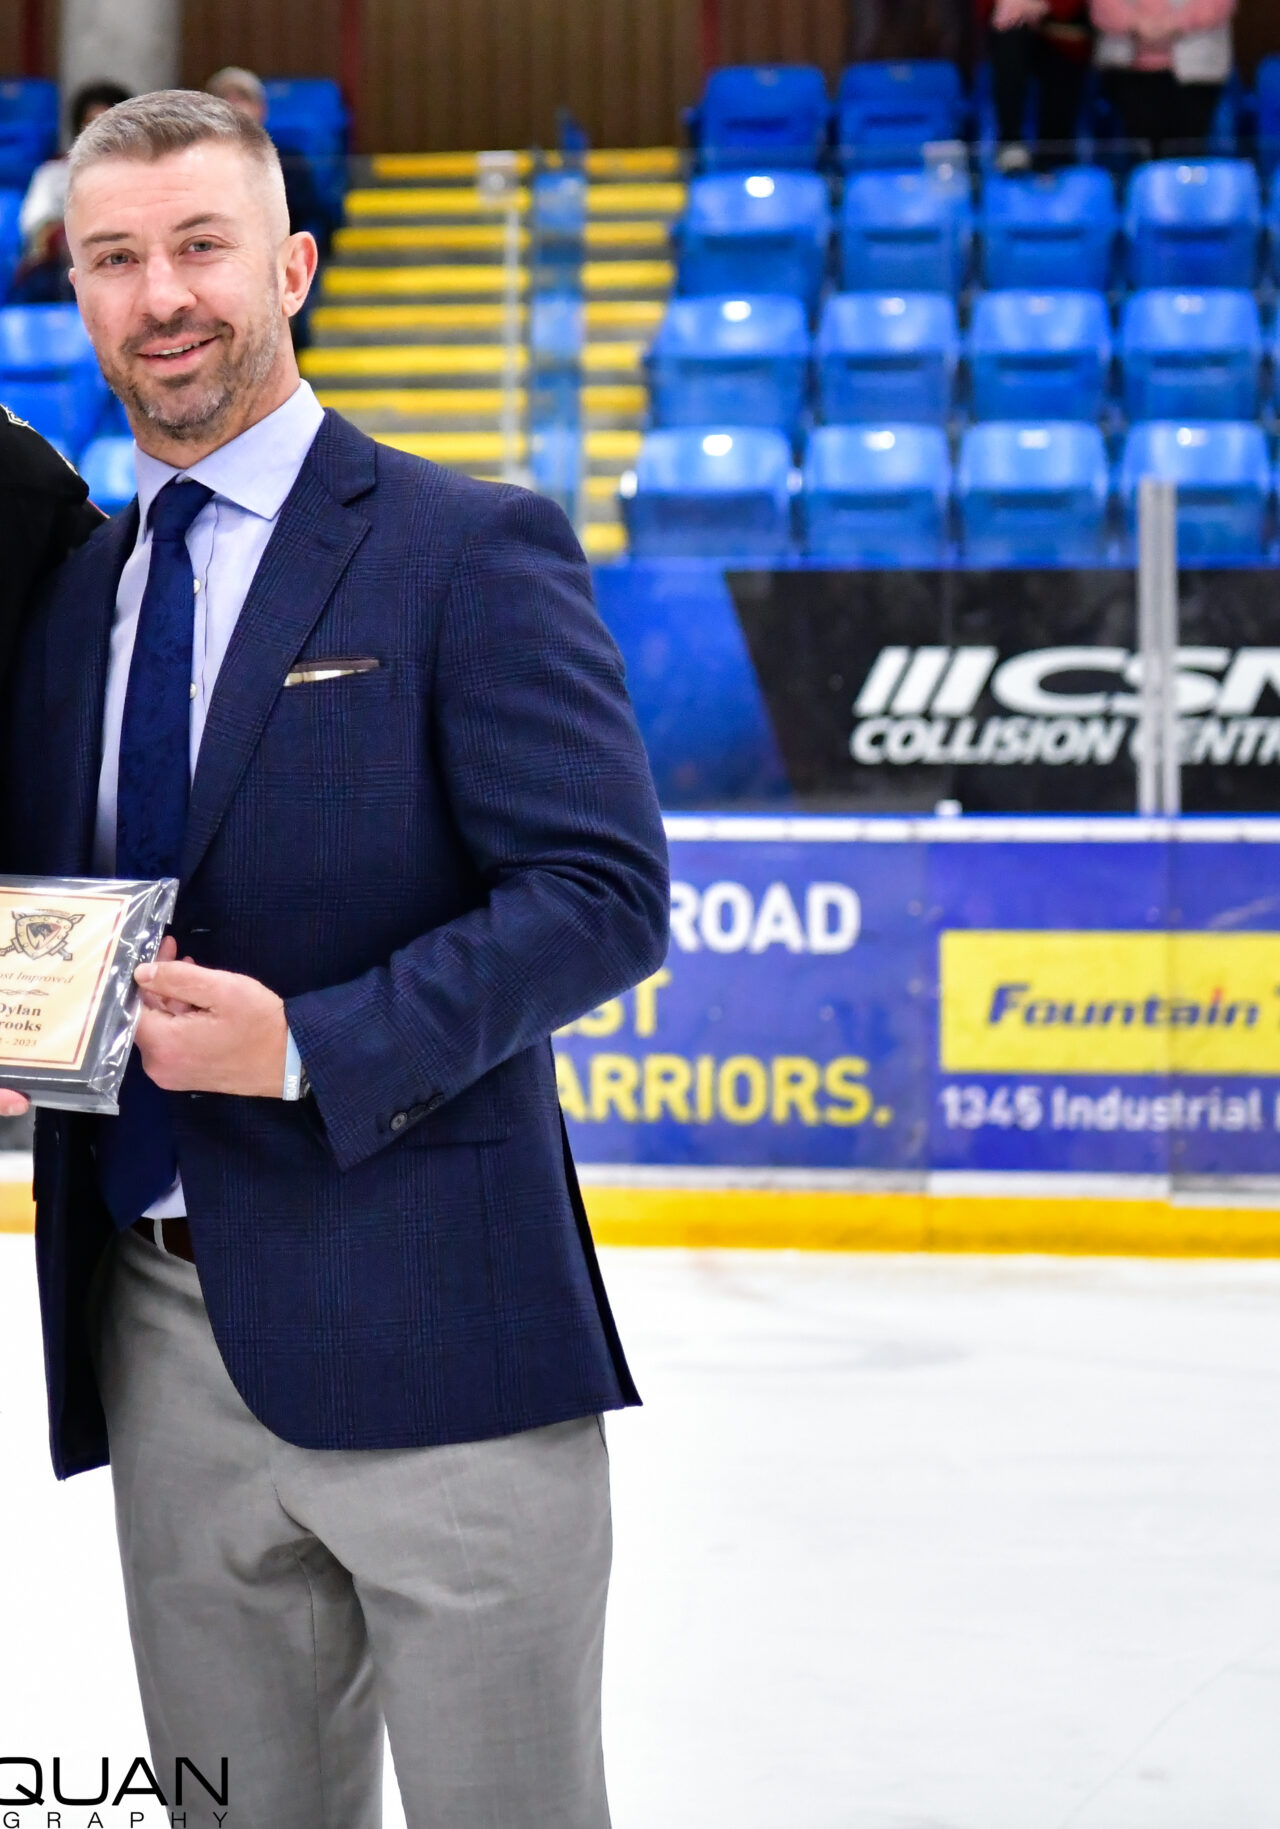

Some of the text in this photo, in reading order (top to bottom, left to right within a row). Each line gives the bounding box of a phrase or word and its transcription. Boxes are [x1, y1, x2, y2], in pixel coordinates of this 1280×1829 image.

[850, 716, 1126, 765] COLLISION
[669, 882, 862, 955] ROAD
[17, 971, 74, 984] Improved
[551, 967, 671, 1038] ST
[987, 981, 1259, 1028] Fountain
[555, 1053, 893, 1127] ARRIORS.
[940, 1084, 1044, 1131] 1345
[1051, 1085, 1263, 1133] Industrial
